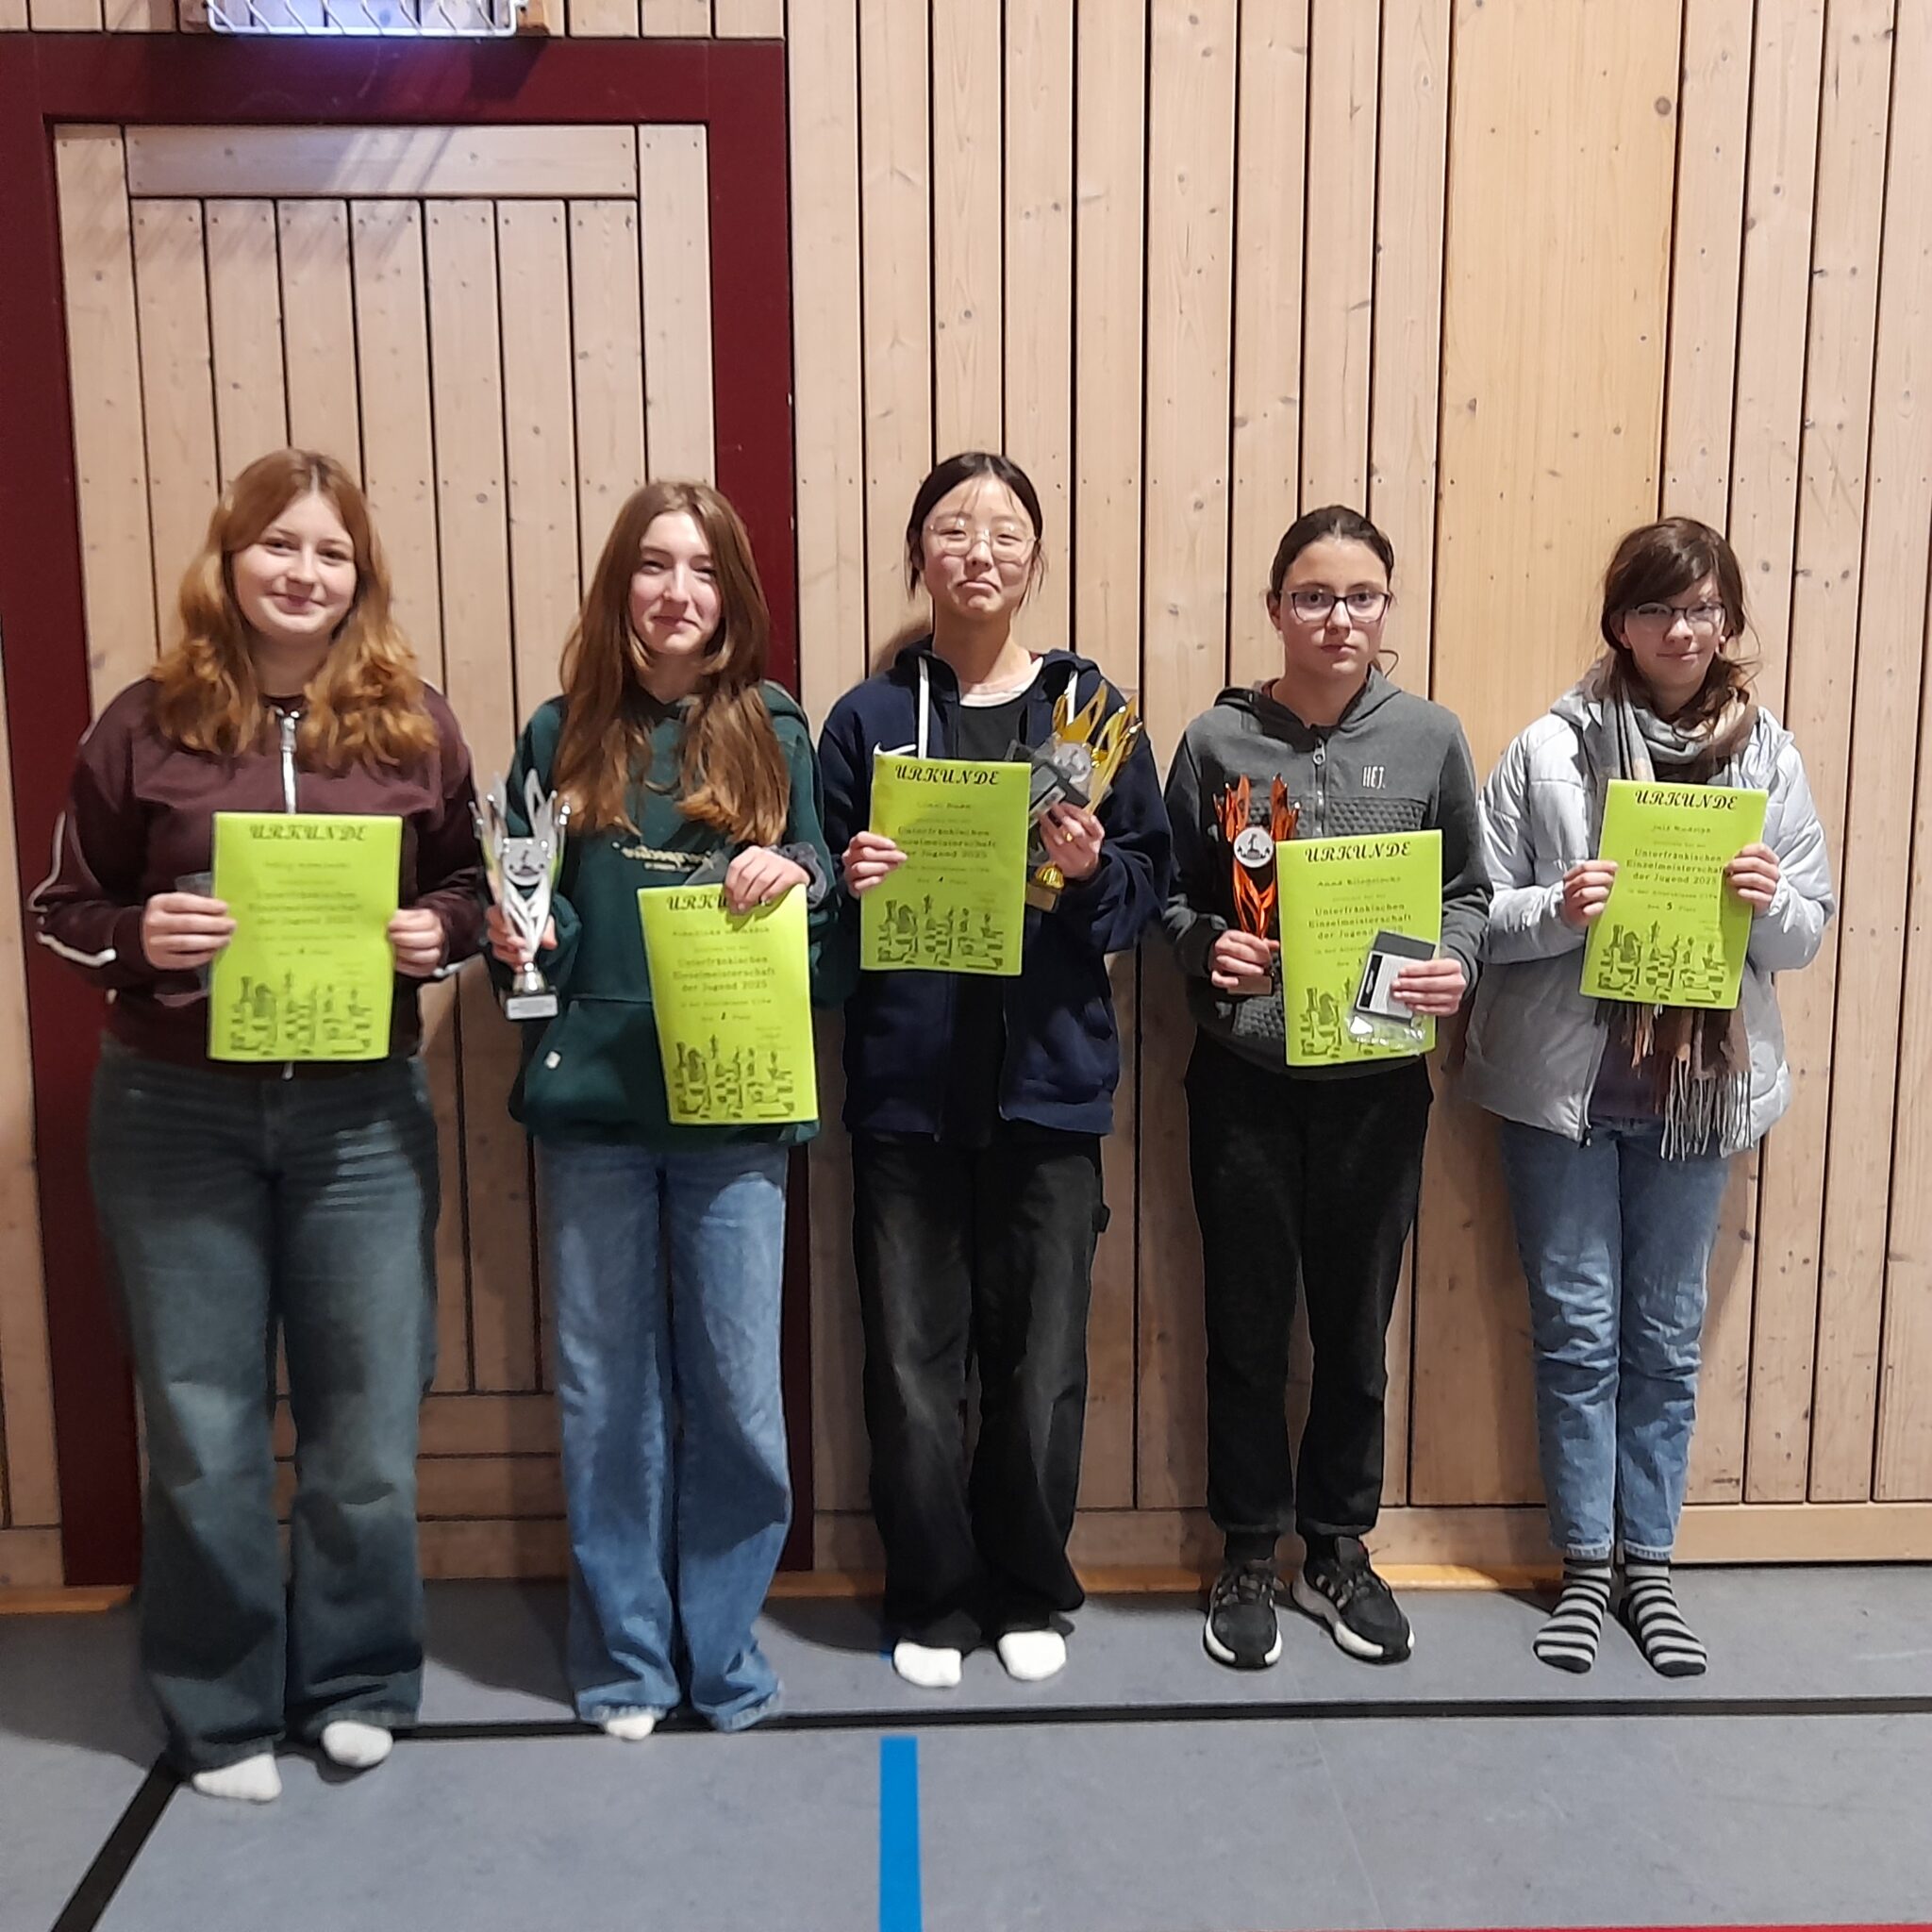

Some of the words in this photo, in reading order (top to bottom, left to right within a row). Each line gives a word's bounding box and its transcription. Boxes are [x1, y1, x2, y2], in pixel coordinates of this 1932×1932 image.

[895, 764, 1000, 785] URKUNDE
[1635, 790, 1738, 809] URKUNDE
[1305, 841, 1411, 863] URKUNDE
[1626, 859, 1724, 874] Einzelmeisterschaf
